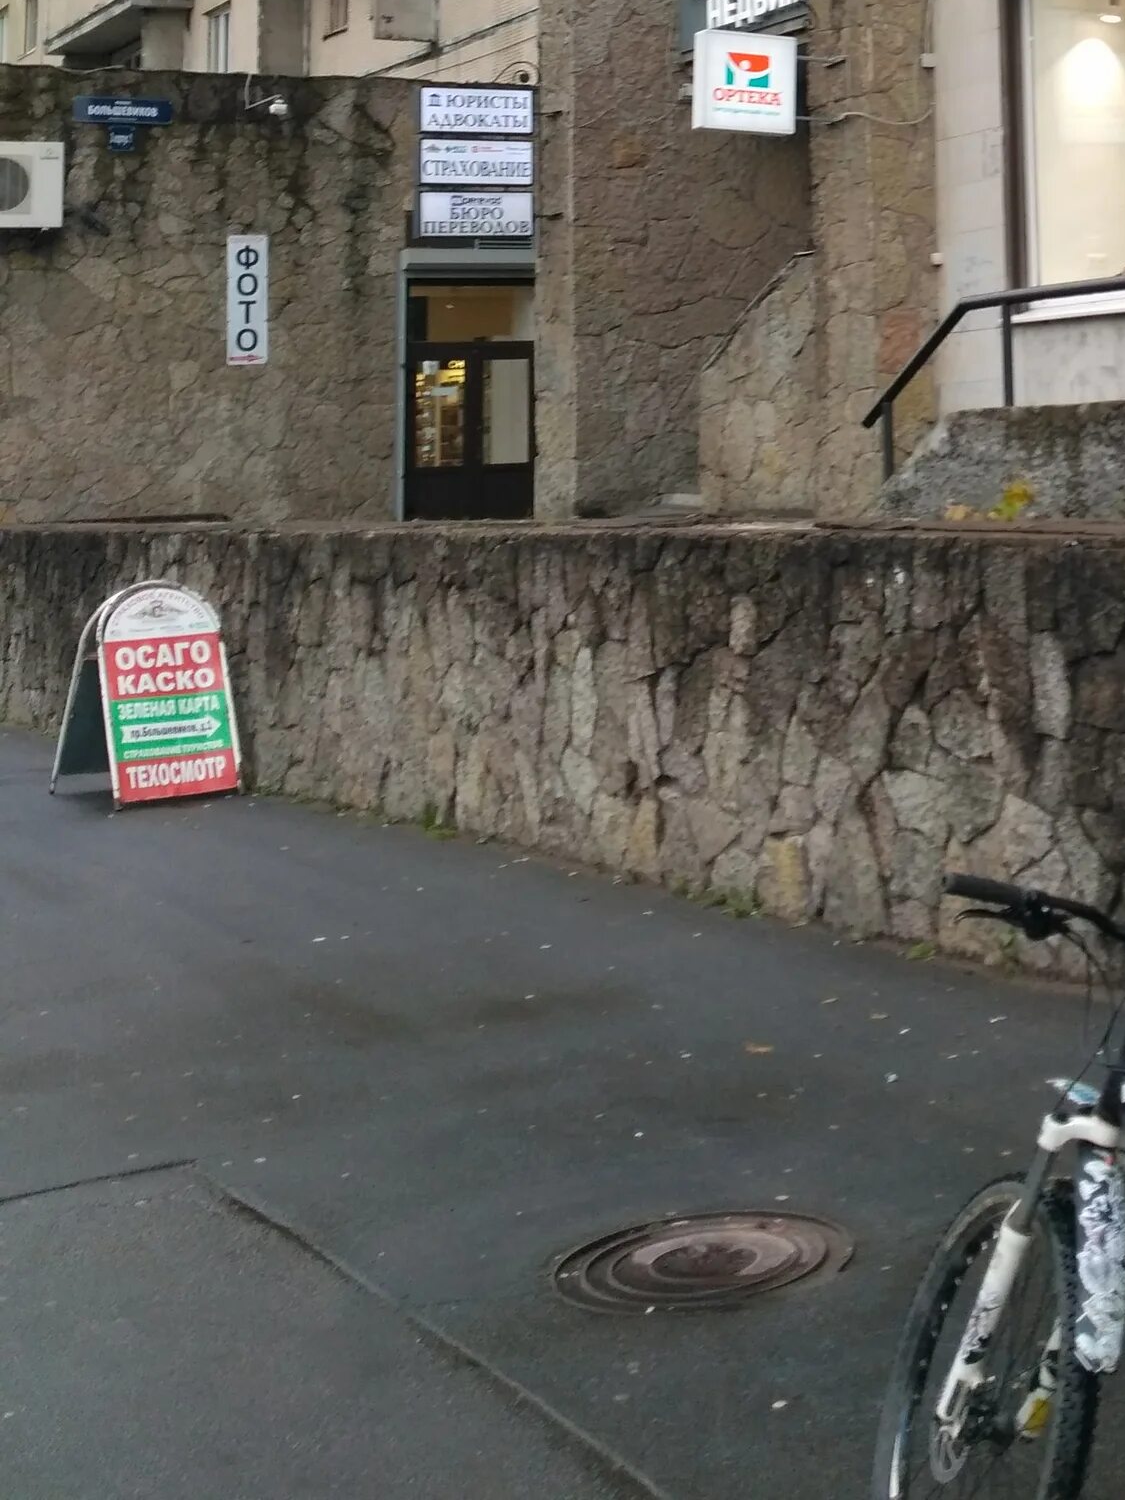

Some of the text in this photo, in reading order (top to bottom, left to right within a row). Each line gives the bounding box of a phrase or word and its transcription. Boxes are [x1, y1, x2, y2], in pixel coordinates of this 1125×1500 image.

[446, 94, 528, 110] ЮРИСТЫ
[712, 87, 782, 106] ОРТЕКА
[87, 104, 159, 118] БОЛЬШЕВИКОВ
[427, 113, 528, 128] АДВОКАТЫ
[422, 159, 532, 178] СТРАХОВАНИЕ
[450, 206, 504, 220] БЮРО
[423, 220, 532, 236] ПЕРЕВОДОВ
[236, 245, 259, 352] ФОТО
[114, 641, 212, 671] ОСАГО
[116, 668, 216, 696] КАСКО
[178, 695, 220, 715] КАРТА
[126, 756, 226, 789] ТЕХОСМОТР
